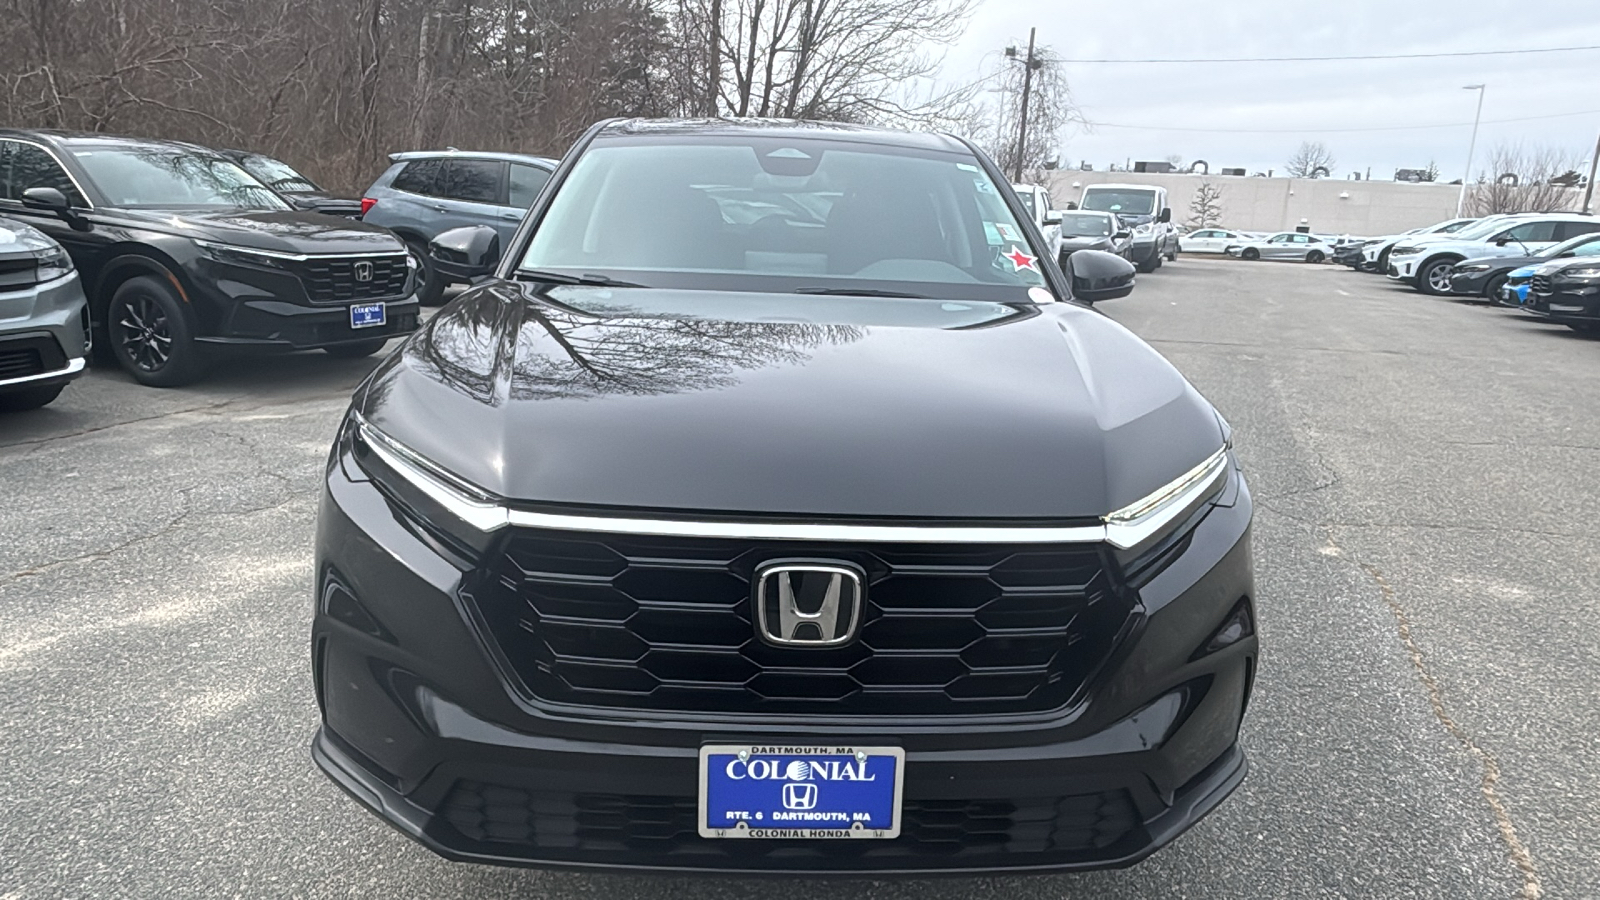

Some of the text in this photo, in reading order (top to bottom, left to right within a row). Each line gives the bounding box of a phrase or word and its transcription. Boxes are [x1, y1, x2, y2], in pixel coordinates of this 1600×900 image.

[751, 746, 854, 755] DARTMOUTH, MA
[726, 759, 875, 781] COLONIAL
[726, 811, 871, 822] RTE. 6 DARTMOUTH, MA
[748, 829, 851, 838] COLONIAL HONDA
